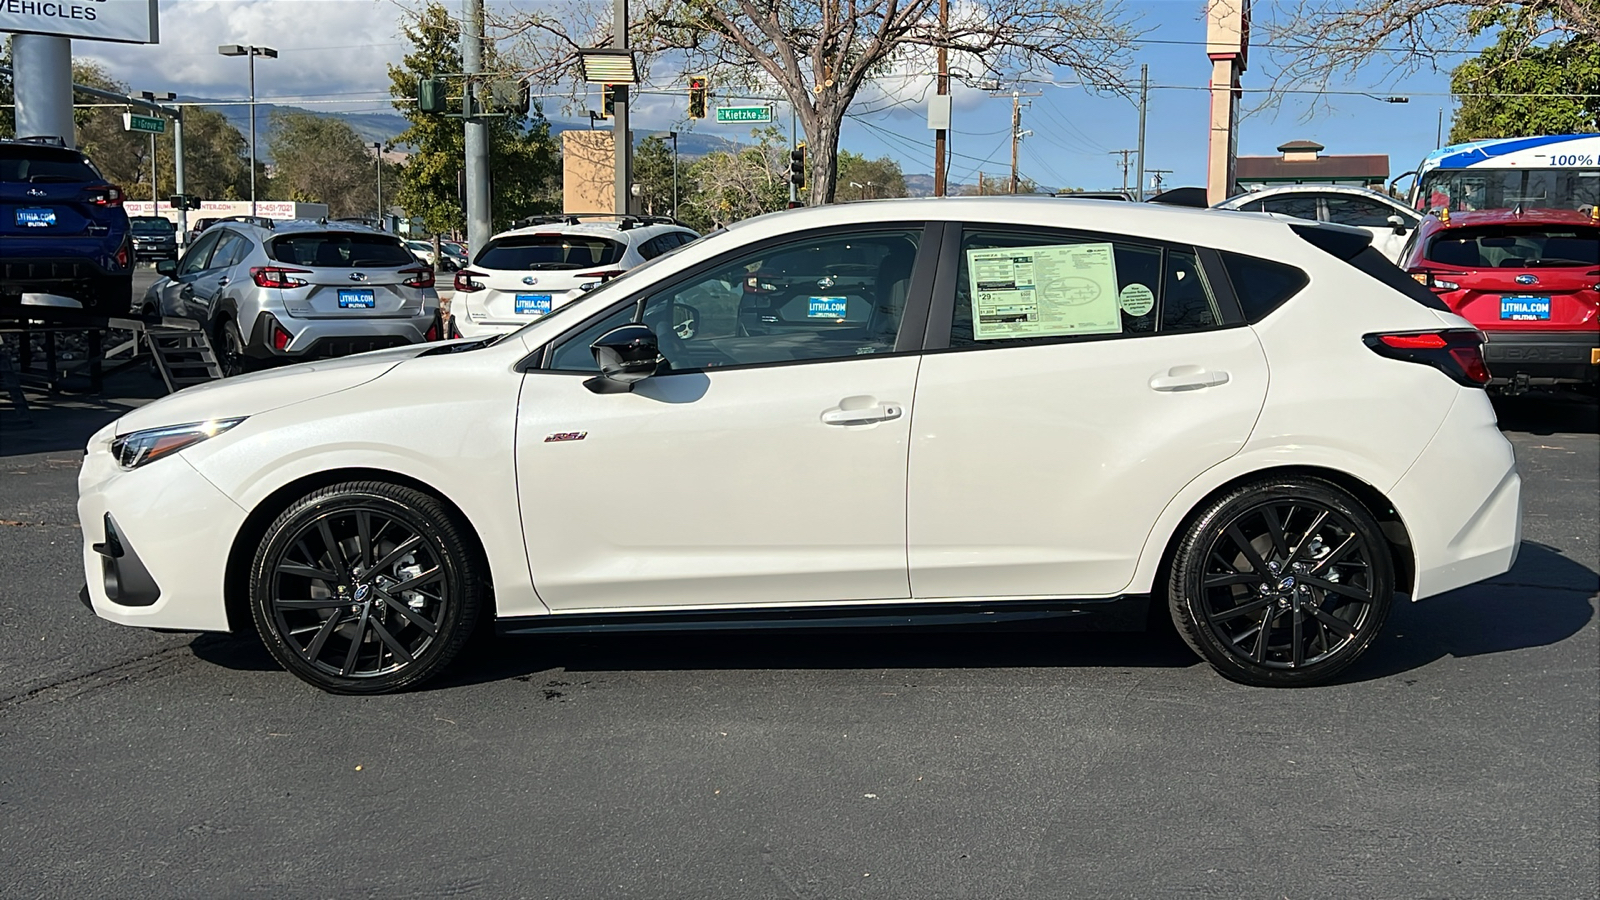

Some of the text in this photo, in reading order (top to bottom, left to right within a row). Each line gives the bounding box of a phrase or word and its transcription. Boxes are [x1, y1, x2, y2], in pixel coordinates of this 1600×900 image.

[725, 109, 757, 120] Kietzke
[140, 119, 157, 130] Grove
[1549, 154, 1593, 166] 100%
[250, 204, 293, 212] 75-451-7021
[16, 212, 56, 221] LITHIA.COM
[339, 294, 374, 303] LITHIA.COM
[981, 293, 992, 301] 29
[516, 300, 551, 308] LITHIA.COM
[809, 302, 846, 311] LITHIA.COM
[1501, 302, 1549, 312] LITHIA.COM
[1486, 346, 1583, 360] UBARU
